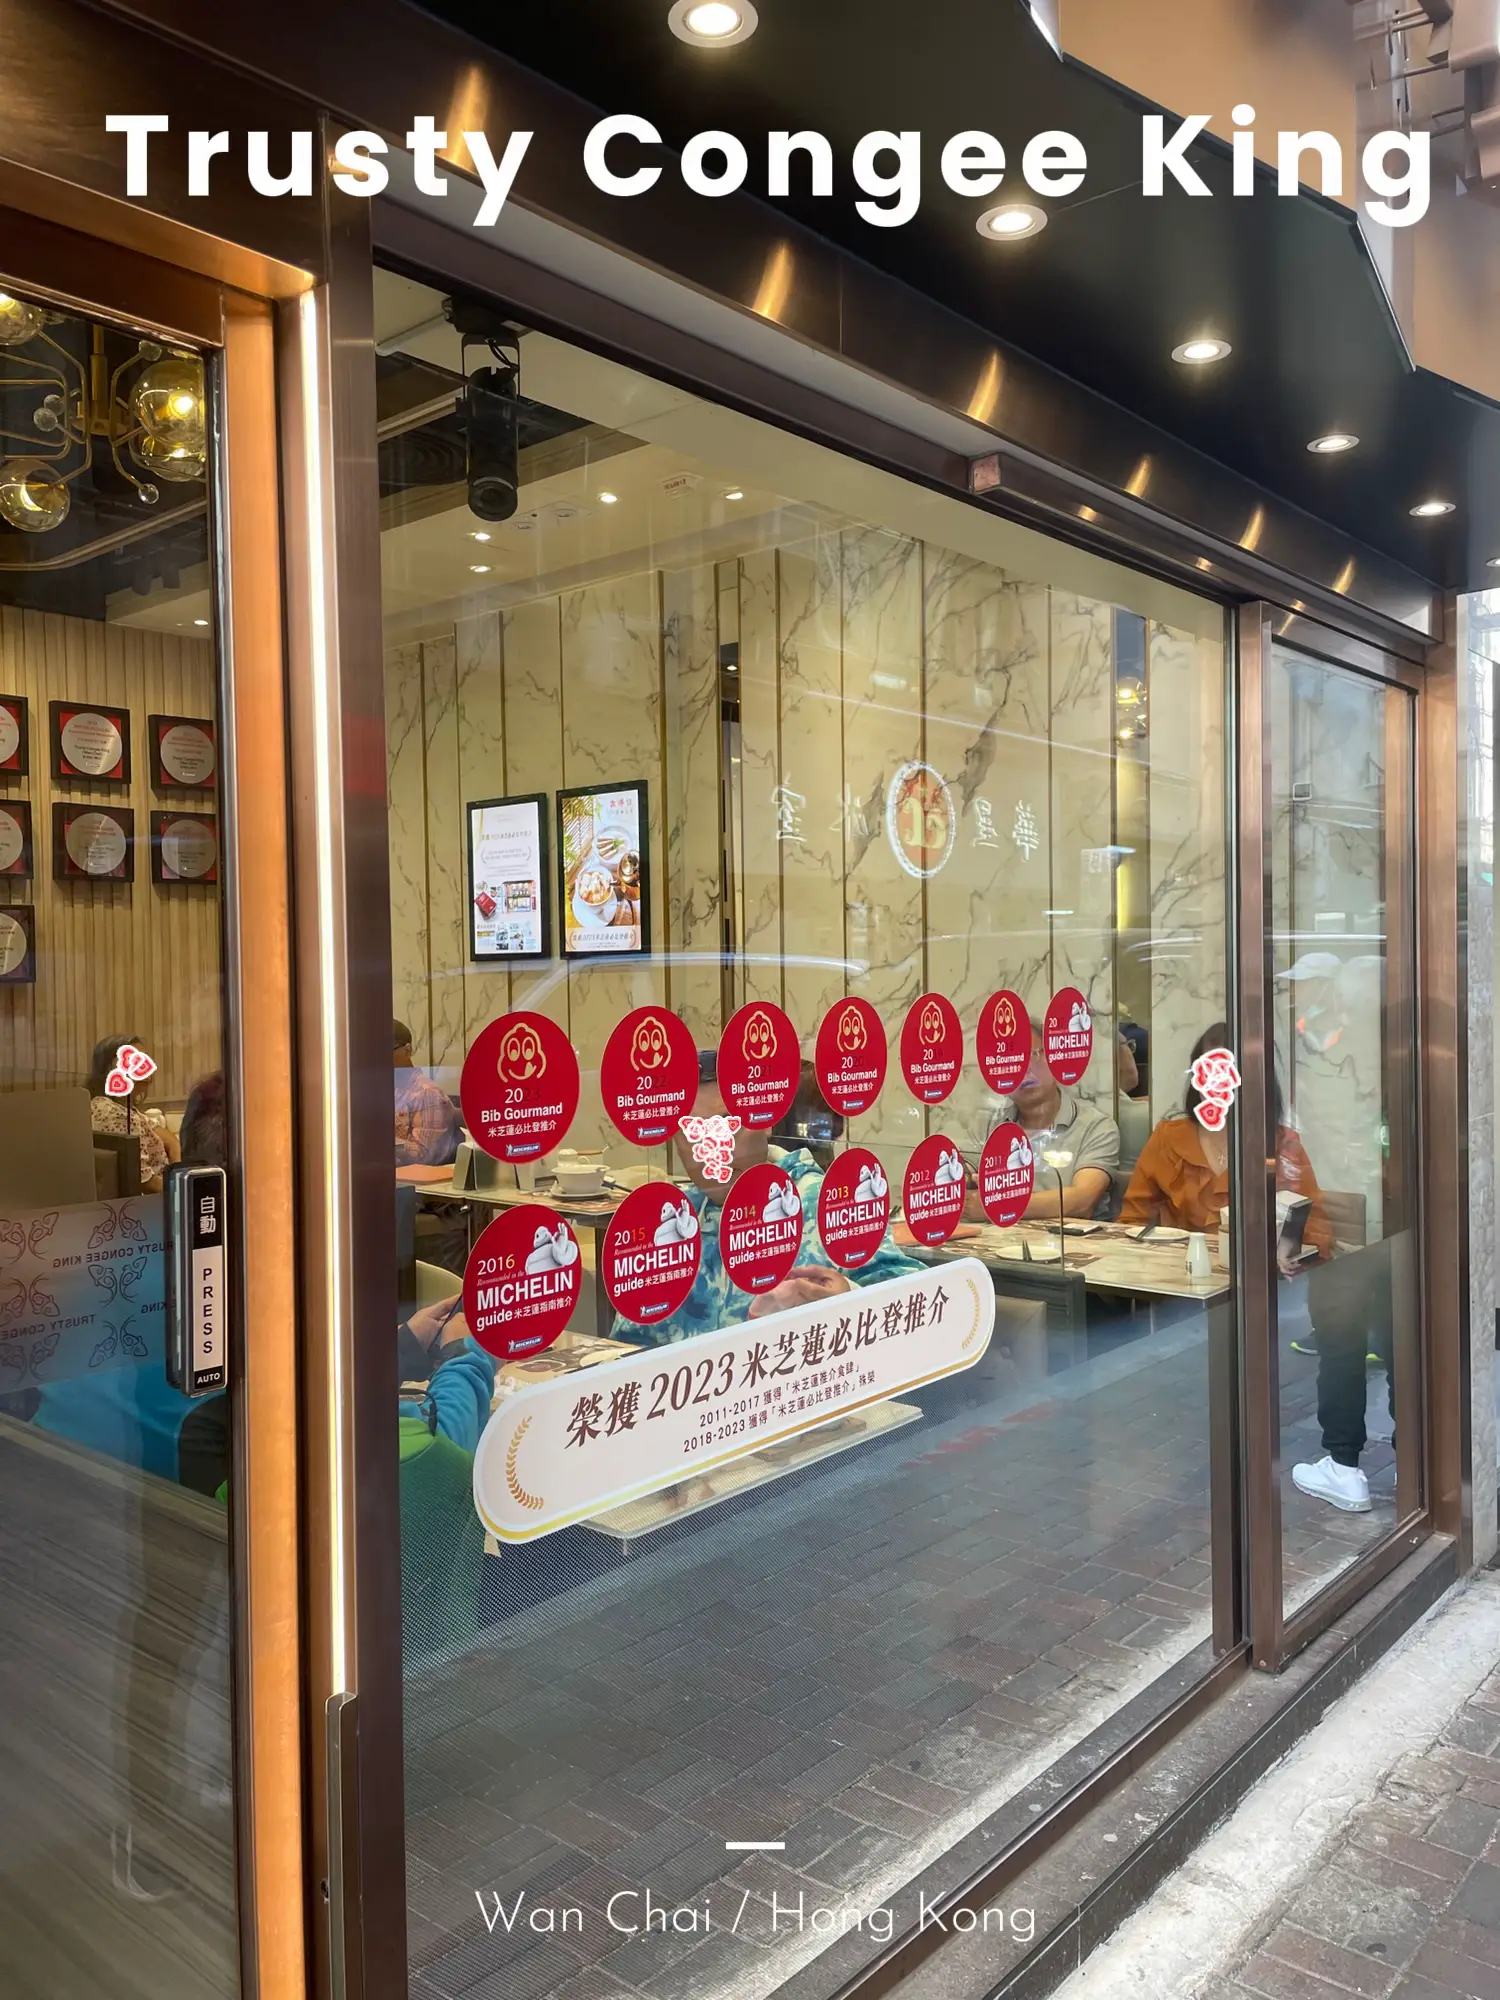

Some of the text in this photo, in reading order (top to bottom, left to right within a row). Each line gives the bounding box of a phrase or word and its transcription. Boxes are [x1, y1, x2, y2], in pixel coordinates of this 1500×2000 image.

[1048, 1033, 1090, 1050] MICHELIN
[910, 1060, 955, 1074] Bib Gourmand
[985, 1052, 1025, 1065] Bib Gourmand
[1048, 1051, 1064, 1064] guide
[827, 1069, 877, 1083] Bib Gourmand
[731, 1078, 789, 1095] Bib Gourmand
[617, 1089, 685, 1108] Bib Gourmand
[481, 1102, 563, 1123] Bib Gourmand
[622, 1105, 681, 1121] 米芝蓮必比登推介
[488, 1120, 557, 1138] 米芝蓮必比登推介
[984, 1155, 1002, 1169] 2011
[909, 1170, 930, 1184] 2012
[984, 1169, 1030, 1193] MICHELIN
[826, 1185, 849, 1202] 2013
[909, 1183, 961, 1210] MICHELIN
[984, 1191, 1002, 1206] guide
[200, 1196, 216, 1234] 自動
[729, 1206, 756, 1222] 2014
[825, 1200, 885, 1229] MICHELIN
[909, 1208, 929, 1225] guide
[614, 1227, 646, 1246] 2015
[729, 1219, 798, 1252] MICHELIN
[825, 1226, 848, 1245] guide
[477, 1254, 515, 1275] 2016
[614, 1242, 694, 1278] MICHELIN
[729, 1249, 755, 1268] guide
[477, 1270, 573, 1310] MICHELIN
[614, 1266, 694, 1297] guide 米芝蓮指南推介
[202, 1267, 214, 1354] PRESS
[476, 1295, 573, 1332] guide 米芝蓮指南推介
[564, 1285, 950, 1451] 榮獲 2023 米芝蓮必比登推介
[197, 1372, 221, 1384] AUTO
[699, 1395, 760, 1427] 2011-2017
[683, 1419, 746, 1453] 2018-2023
